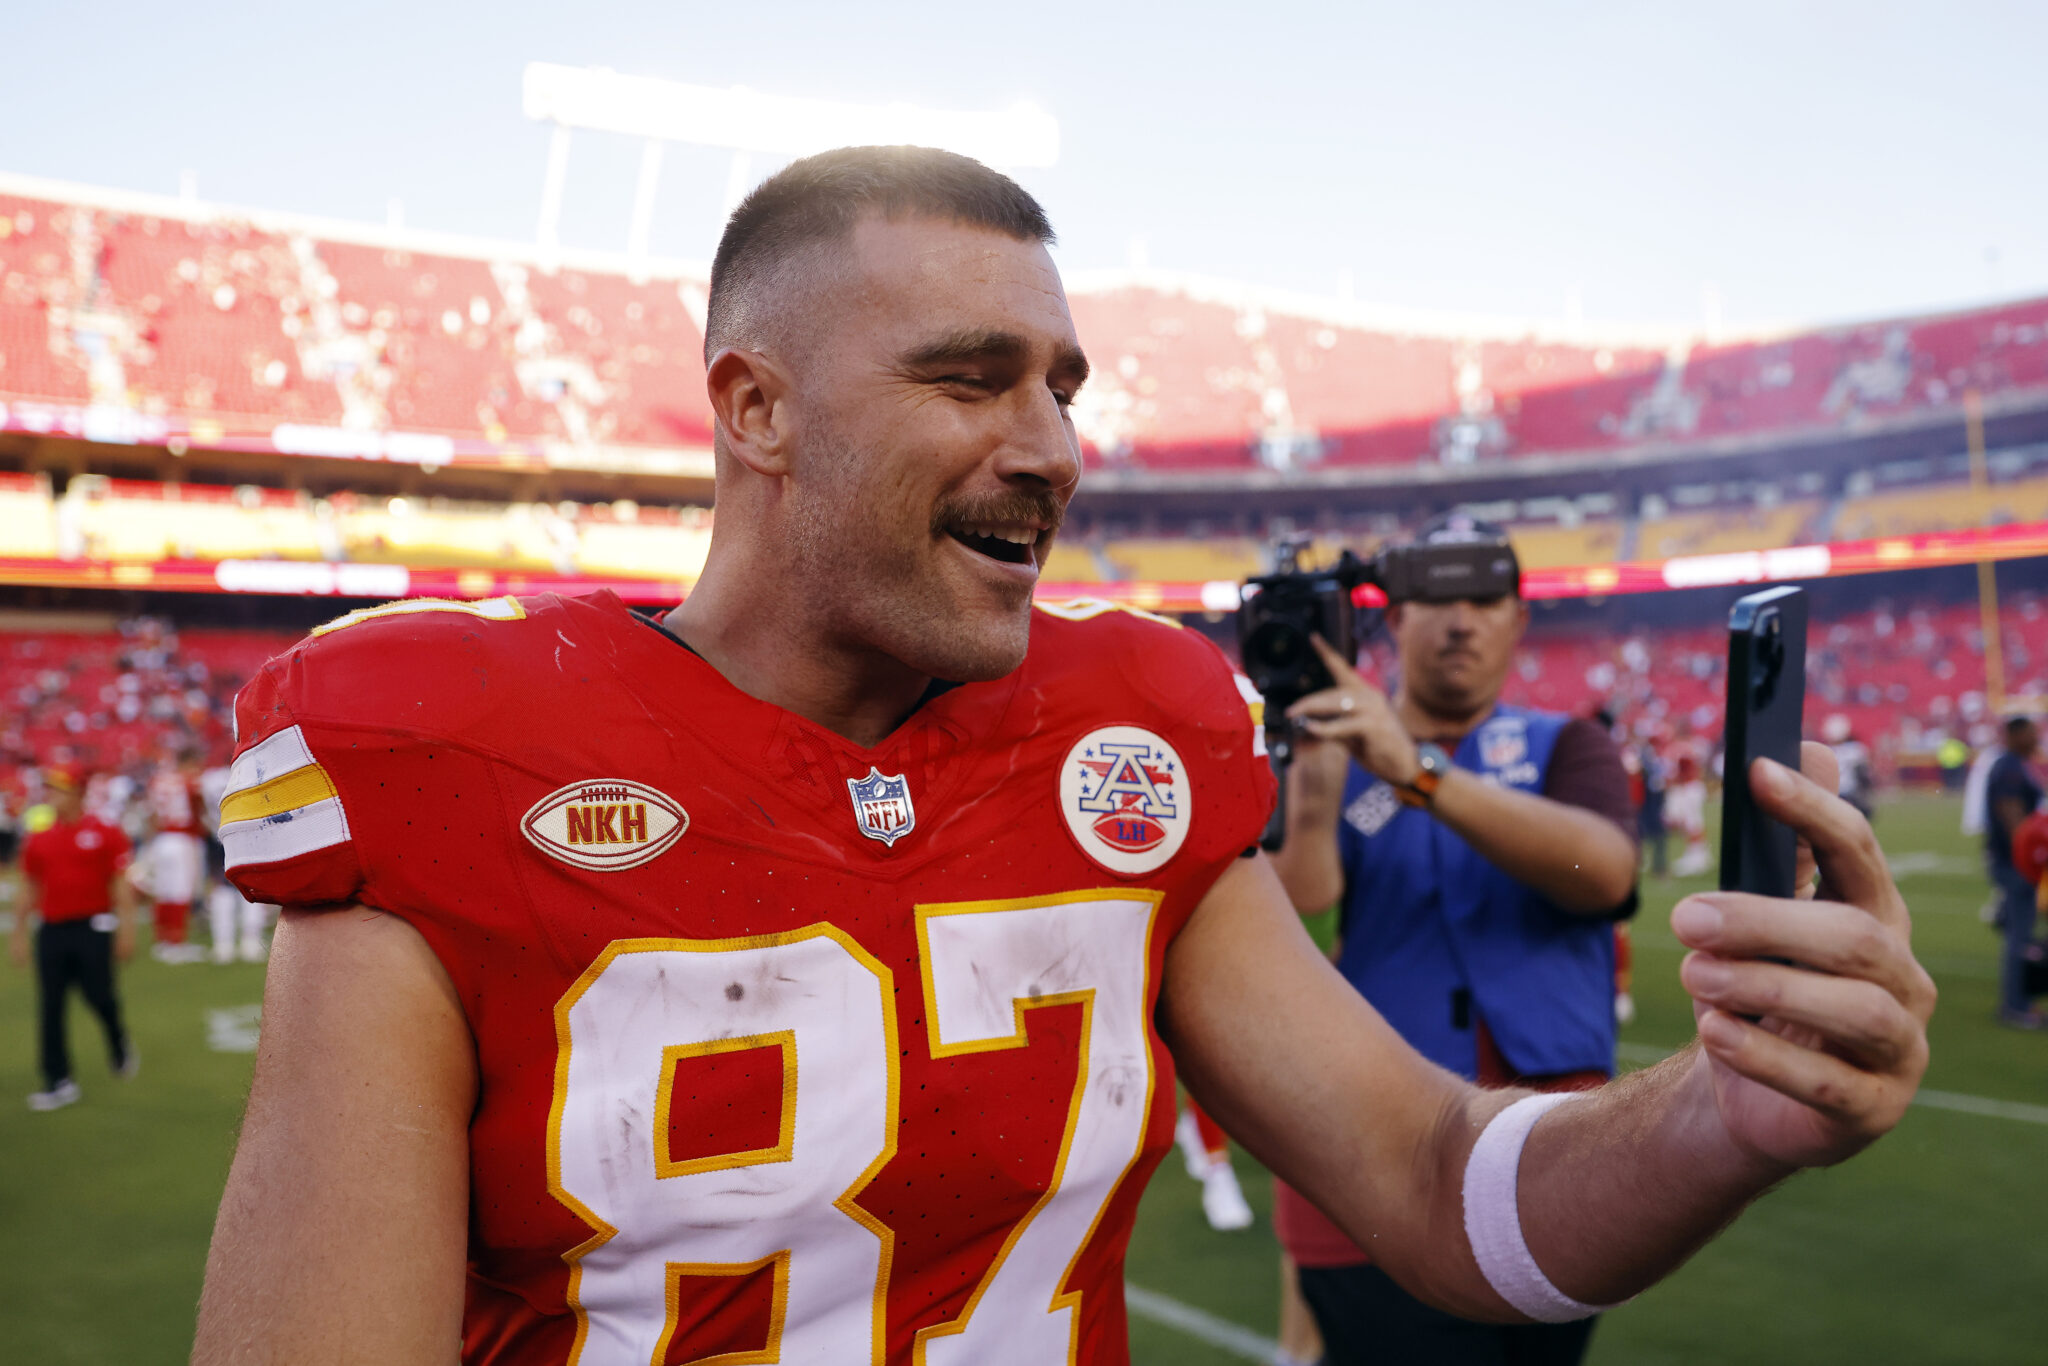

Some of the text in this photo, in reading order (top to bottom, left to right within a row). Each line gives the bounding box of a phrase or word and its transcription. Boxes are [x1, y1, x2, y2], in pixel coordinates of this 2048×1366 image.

[1079, 743, 1177, 819] A
[566, 803, 648, 845] NKH
[864, 800, 906, 832] NFL
[1116, 822, 1147, 841] LH
[546, 887, 1165, 1366] 87
